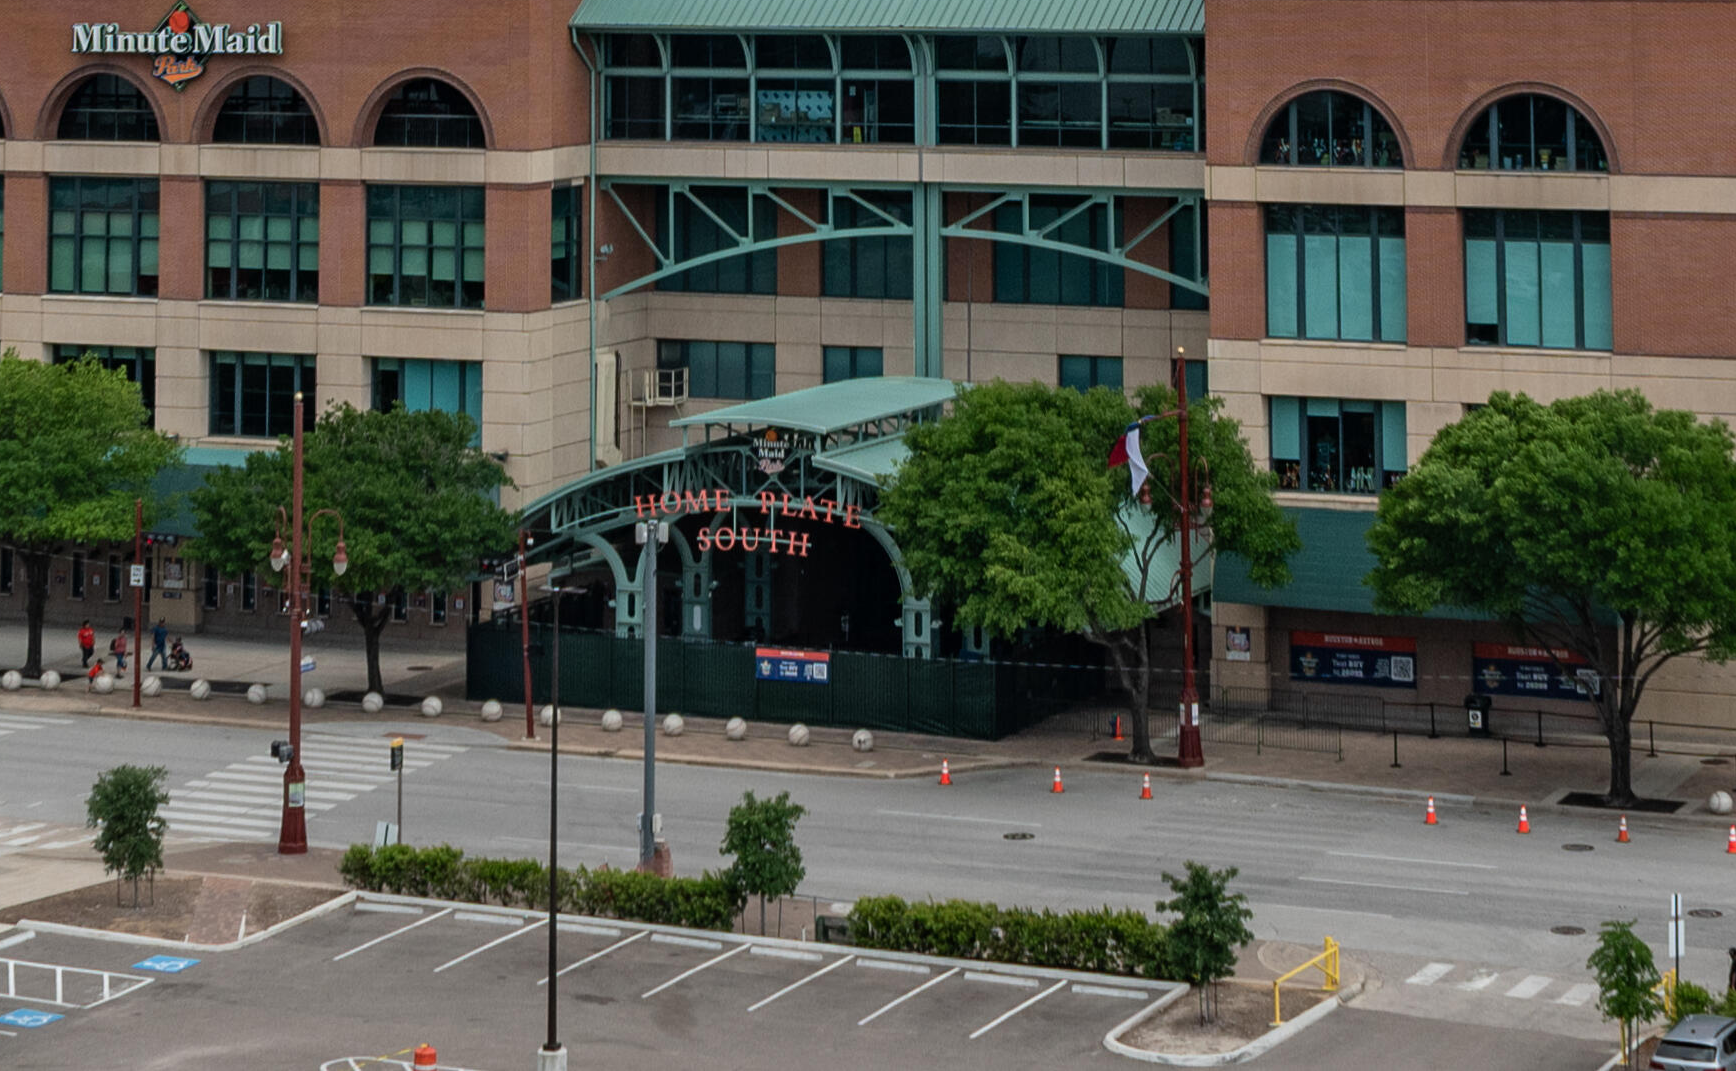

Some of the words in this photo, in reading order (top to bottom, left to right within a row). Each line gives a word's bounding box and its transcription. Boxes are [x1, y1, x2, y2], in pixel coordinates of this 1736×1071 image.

[71, 22, 192, 55] Minute
[193, 20, 283, 55] Maid
[153, 55, 204, 84] Park
[753, 437, 790, 449] Minute
[758, 448, 785, 459] Maid
[634, 489, 731, 518] HOME
[760, 491, 862, 529] PLATE
[698, 527, 810, 557] SOUTH
